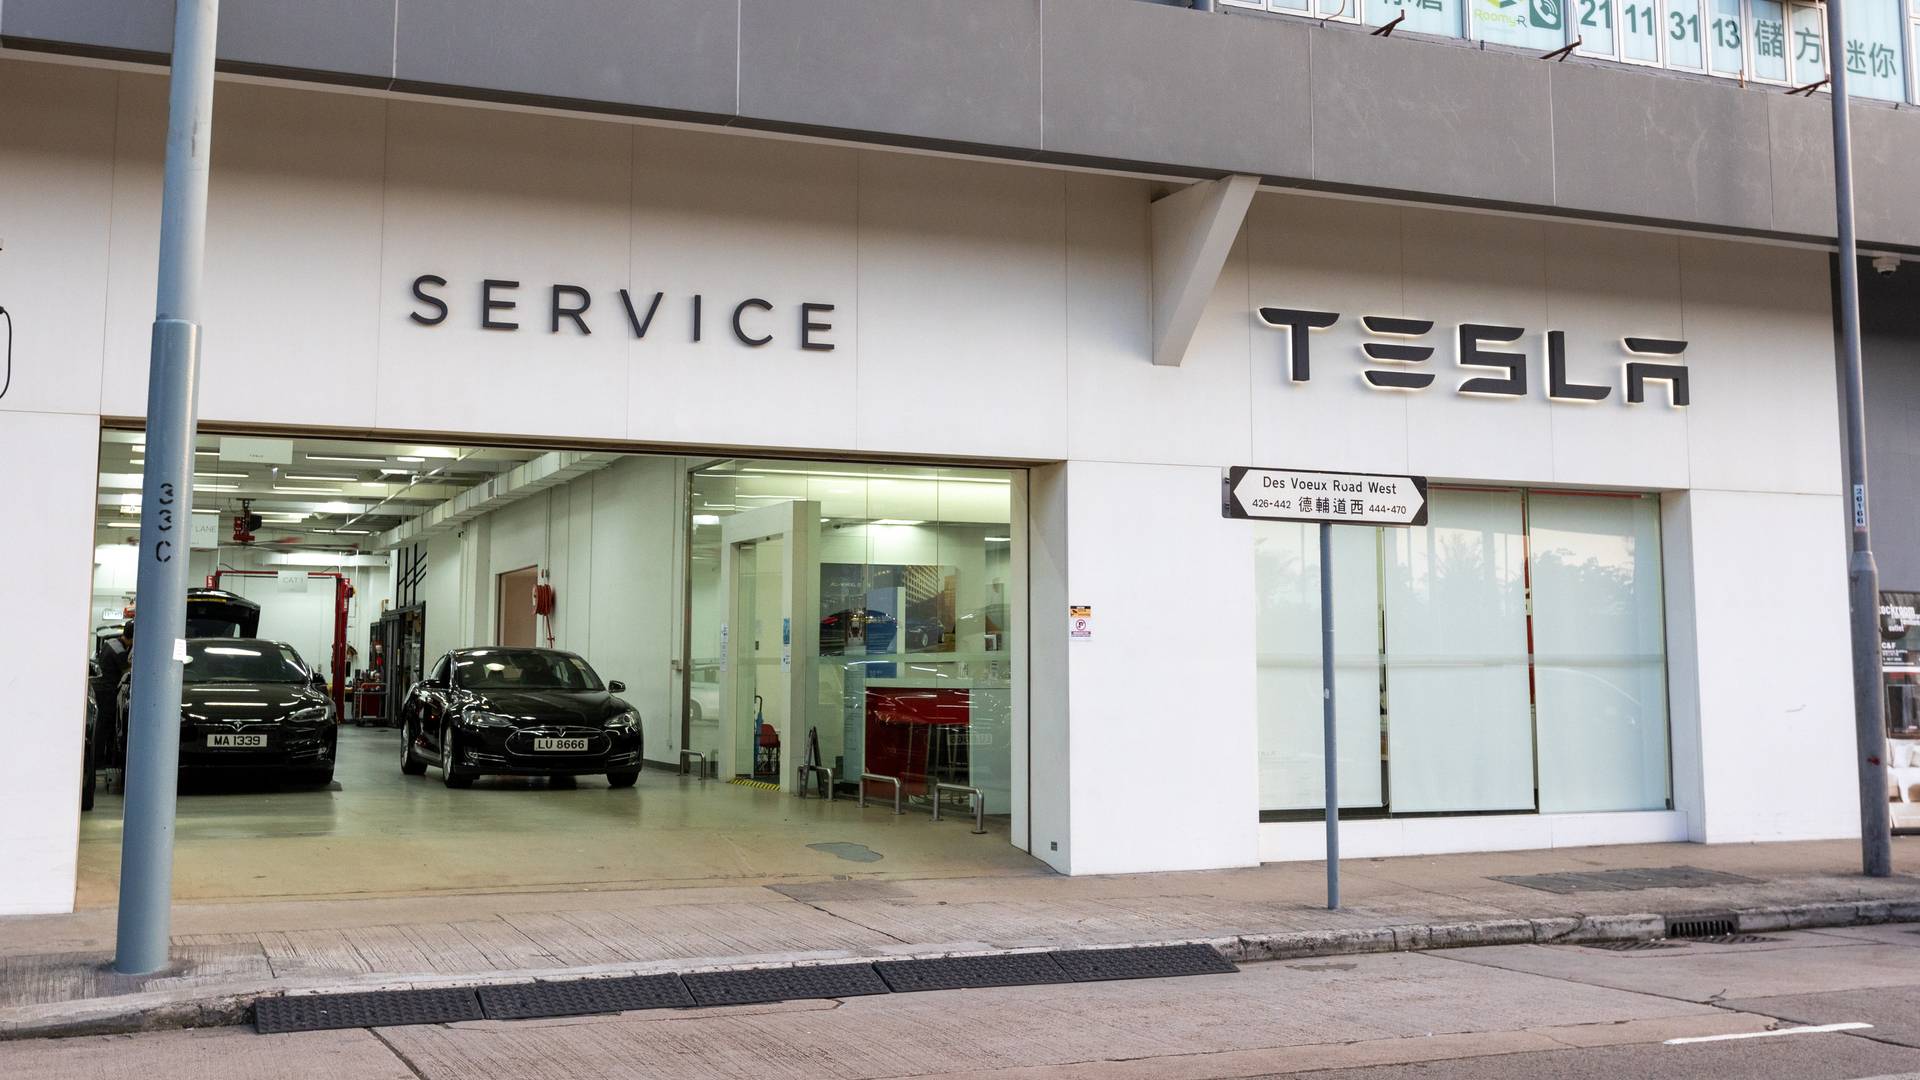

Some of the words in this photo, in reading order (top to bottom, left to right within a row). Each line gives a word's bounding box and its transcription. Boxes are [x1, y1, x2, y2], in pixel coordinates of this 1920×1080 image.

[410, 274, 835, 350] SERVICE
[1259, 307, 1690, 406] TESLA
[1263, 476, 1285, 488] Des
[1291, 477, 1327, 491] Voeux
[1333, 480, 1363, 492] Road
[1368, 482, 1397, 494] West
[1252, 499, 1291, 509] 426-442
[1298, 496, 1364, 515] 德輔道西
[1369, 505, 1406, 515] 444-470
[214, 736, 230, 745] MA
[233, 736, 261, 745] 1339
[538, 740, 552, 749] LU
[557, 740, 584, 749] 8666
